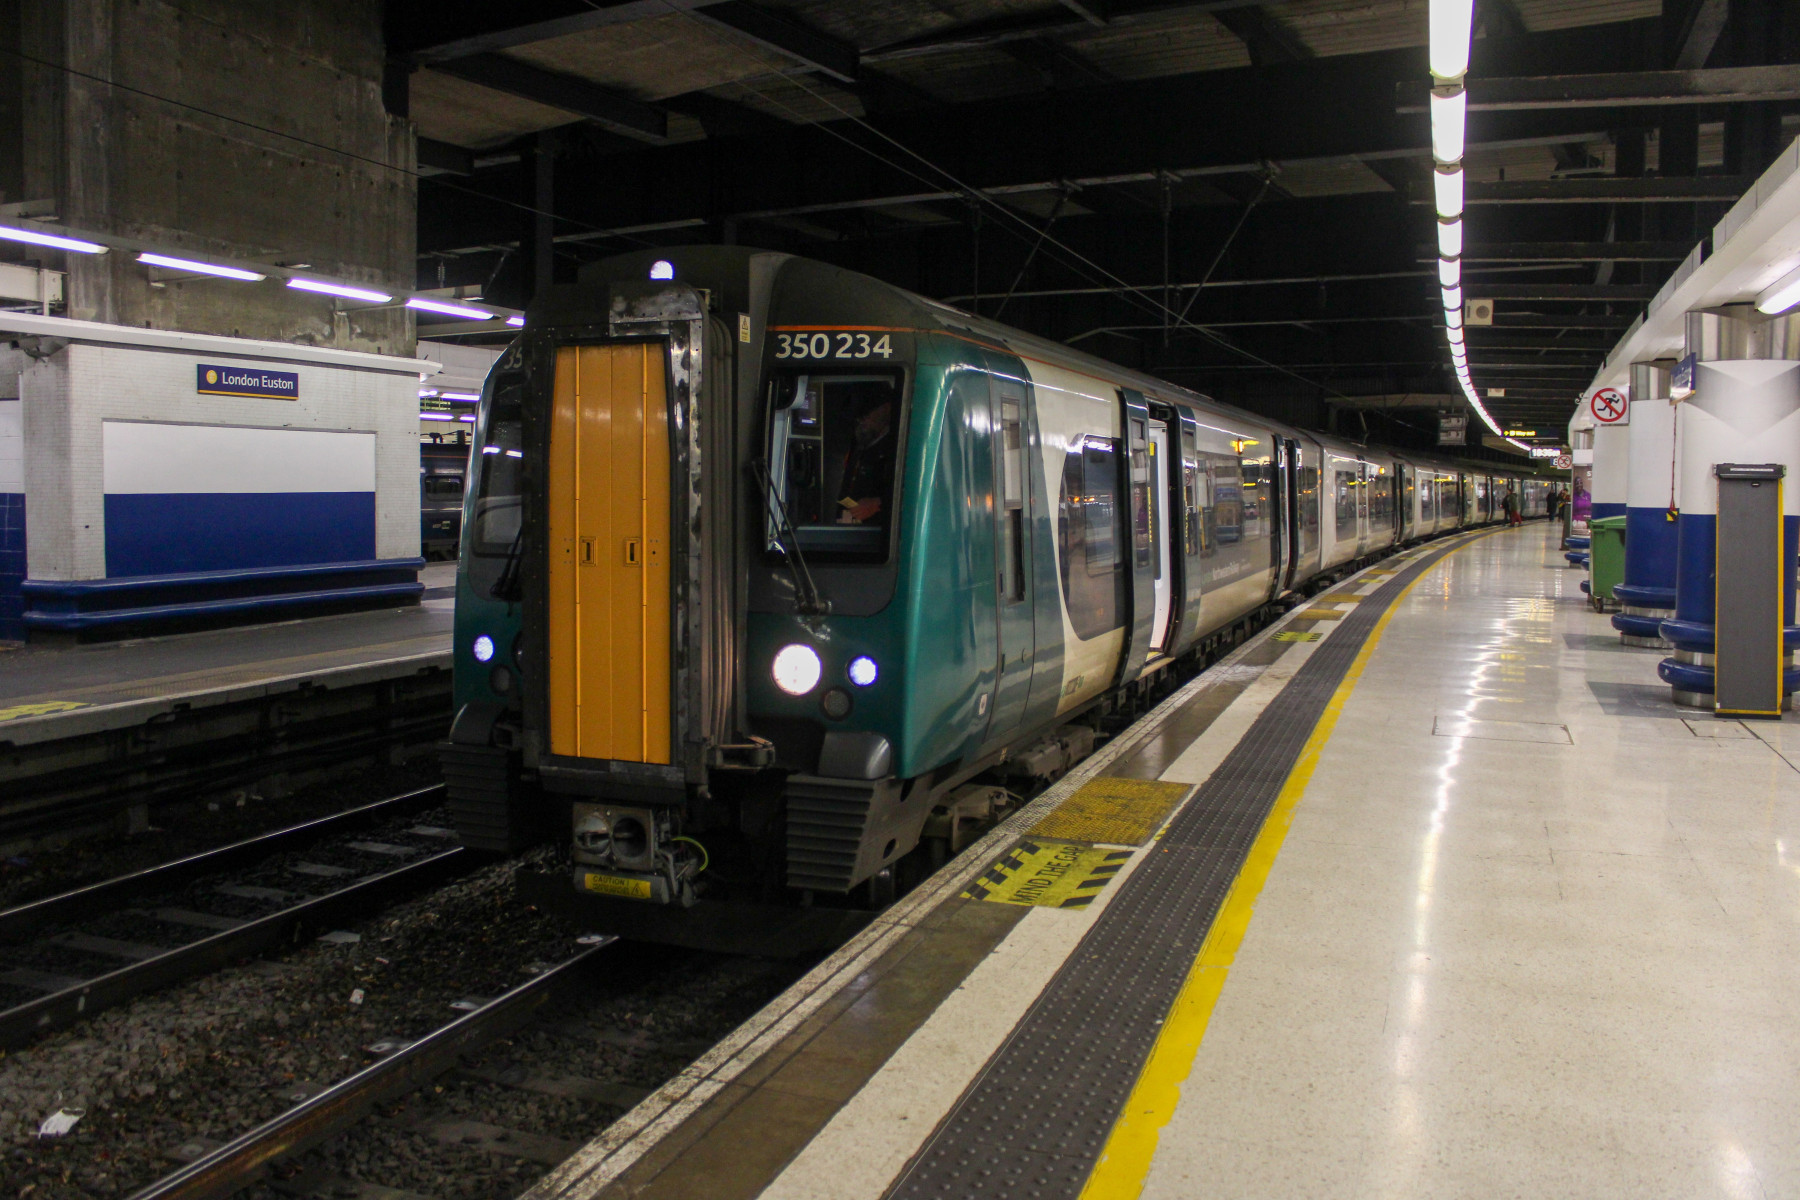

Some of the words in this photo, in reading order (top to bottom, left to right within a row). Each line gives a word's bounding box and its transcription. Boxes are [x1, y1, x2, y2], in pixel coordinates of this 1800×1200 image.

[775, 333, 830, 359] 350
[835, 333, 893, 359] 234
[222, 371, 259, 387] London
[261, 375, 294, 390] Euston
[1007, 878, 1053, 905] MIND
[1035, 861, 1072, 877] THE
